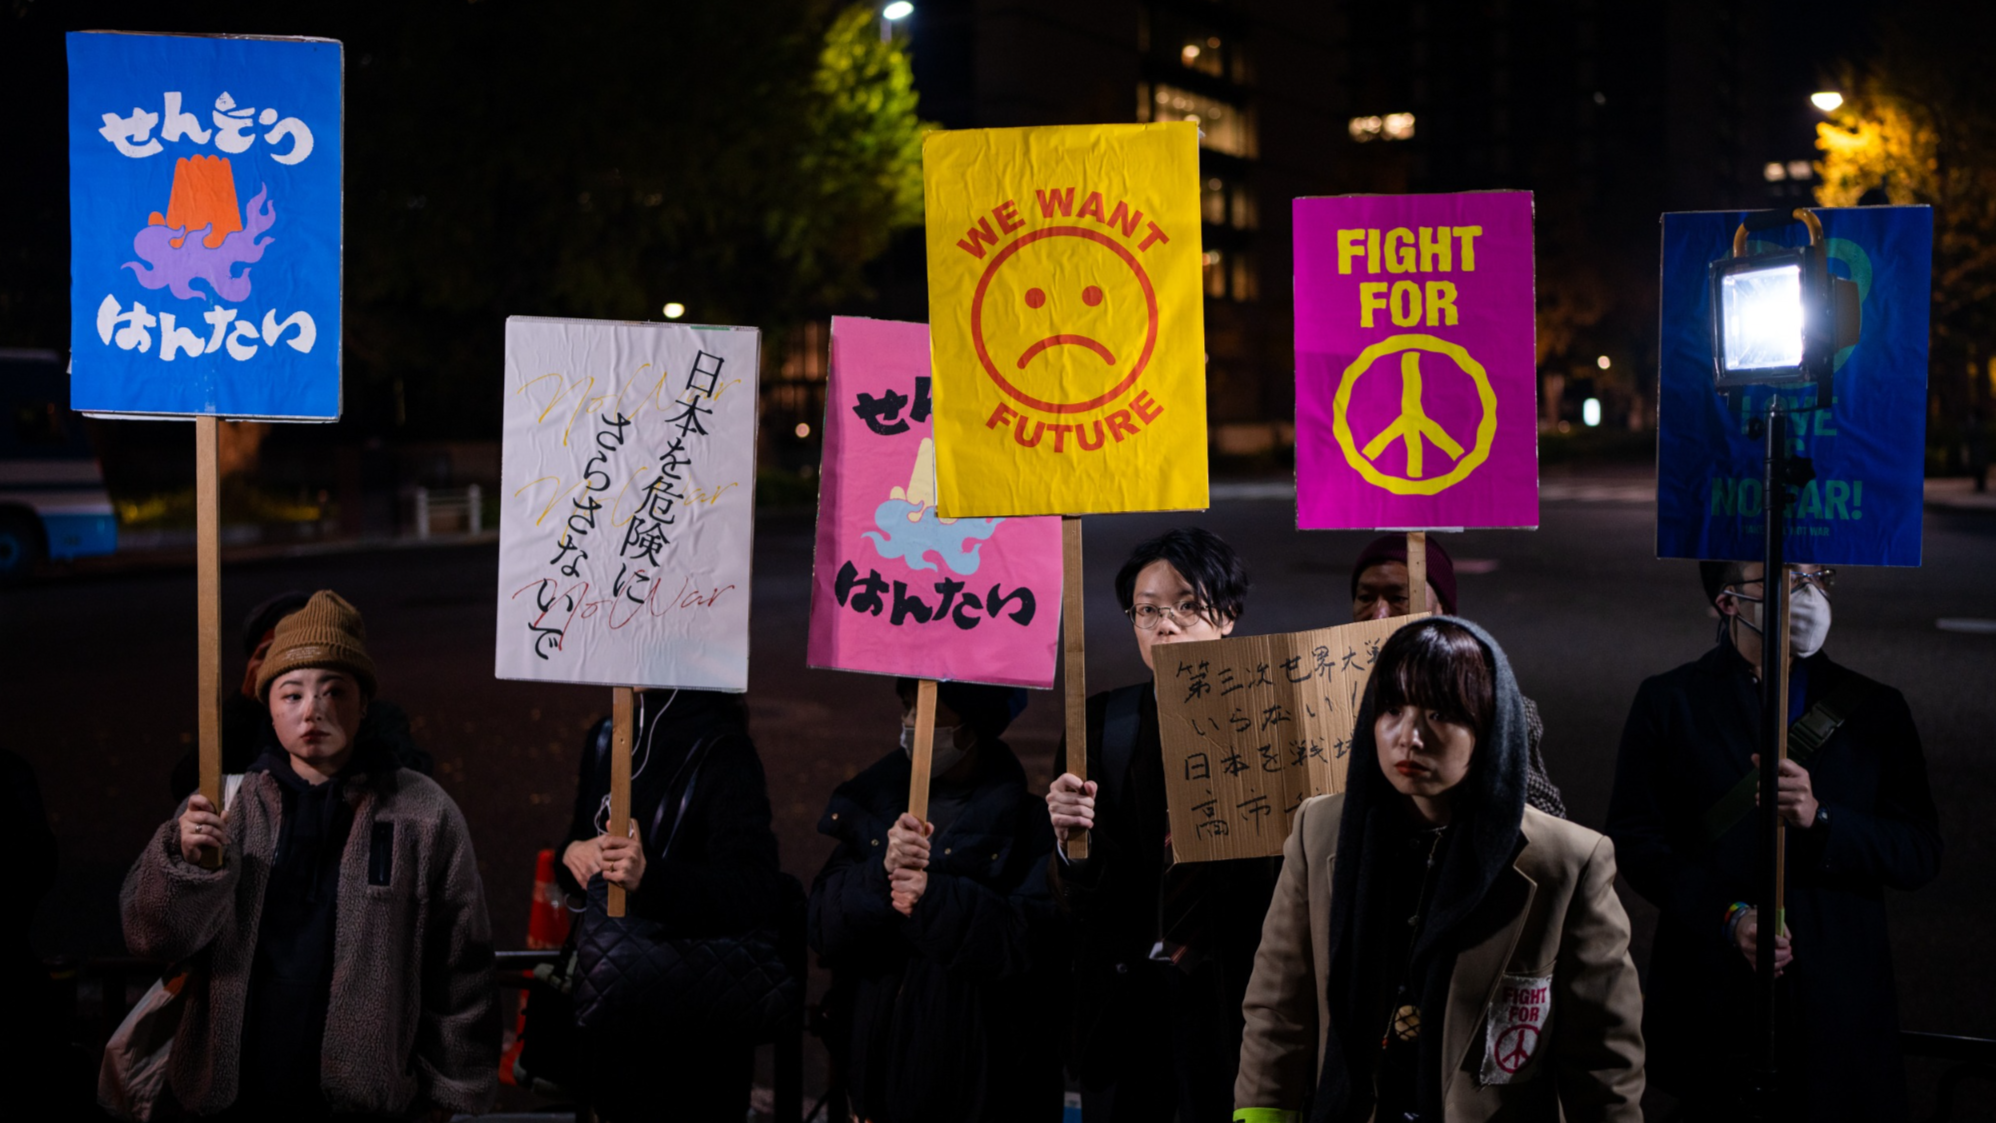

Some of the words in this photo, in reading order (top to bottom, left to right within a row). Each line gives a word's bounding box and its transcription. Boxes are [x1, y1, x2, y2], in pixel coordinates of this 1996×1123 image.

[98, 91, 314, 165] せんそう
[956, 199, 1026, 260] WE
[1036, 187, 1170, 253] WANT
[1337, 225, 1483, 275] FIGHT
[97, 293, 317, 362] はんたい
[1360, 280, 1459, 327] FOR
[985, 389, 1165, 453] FUTURE
[613, 349, 725, 604] 日本を危険に
[1711, 477, 1763, 518] NO
[528, 412, 632, 661] さらさないで
[834, 560, 1036, 630] はんたい
[1503, 987, 1547, 1005] FIGHT
[1508, 1006, 1539, 1022] FOR
